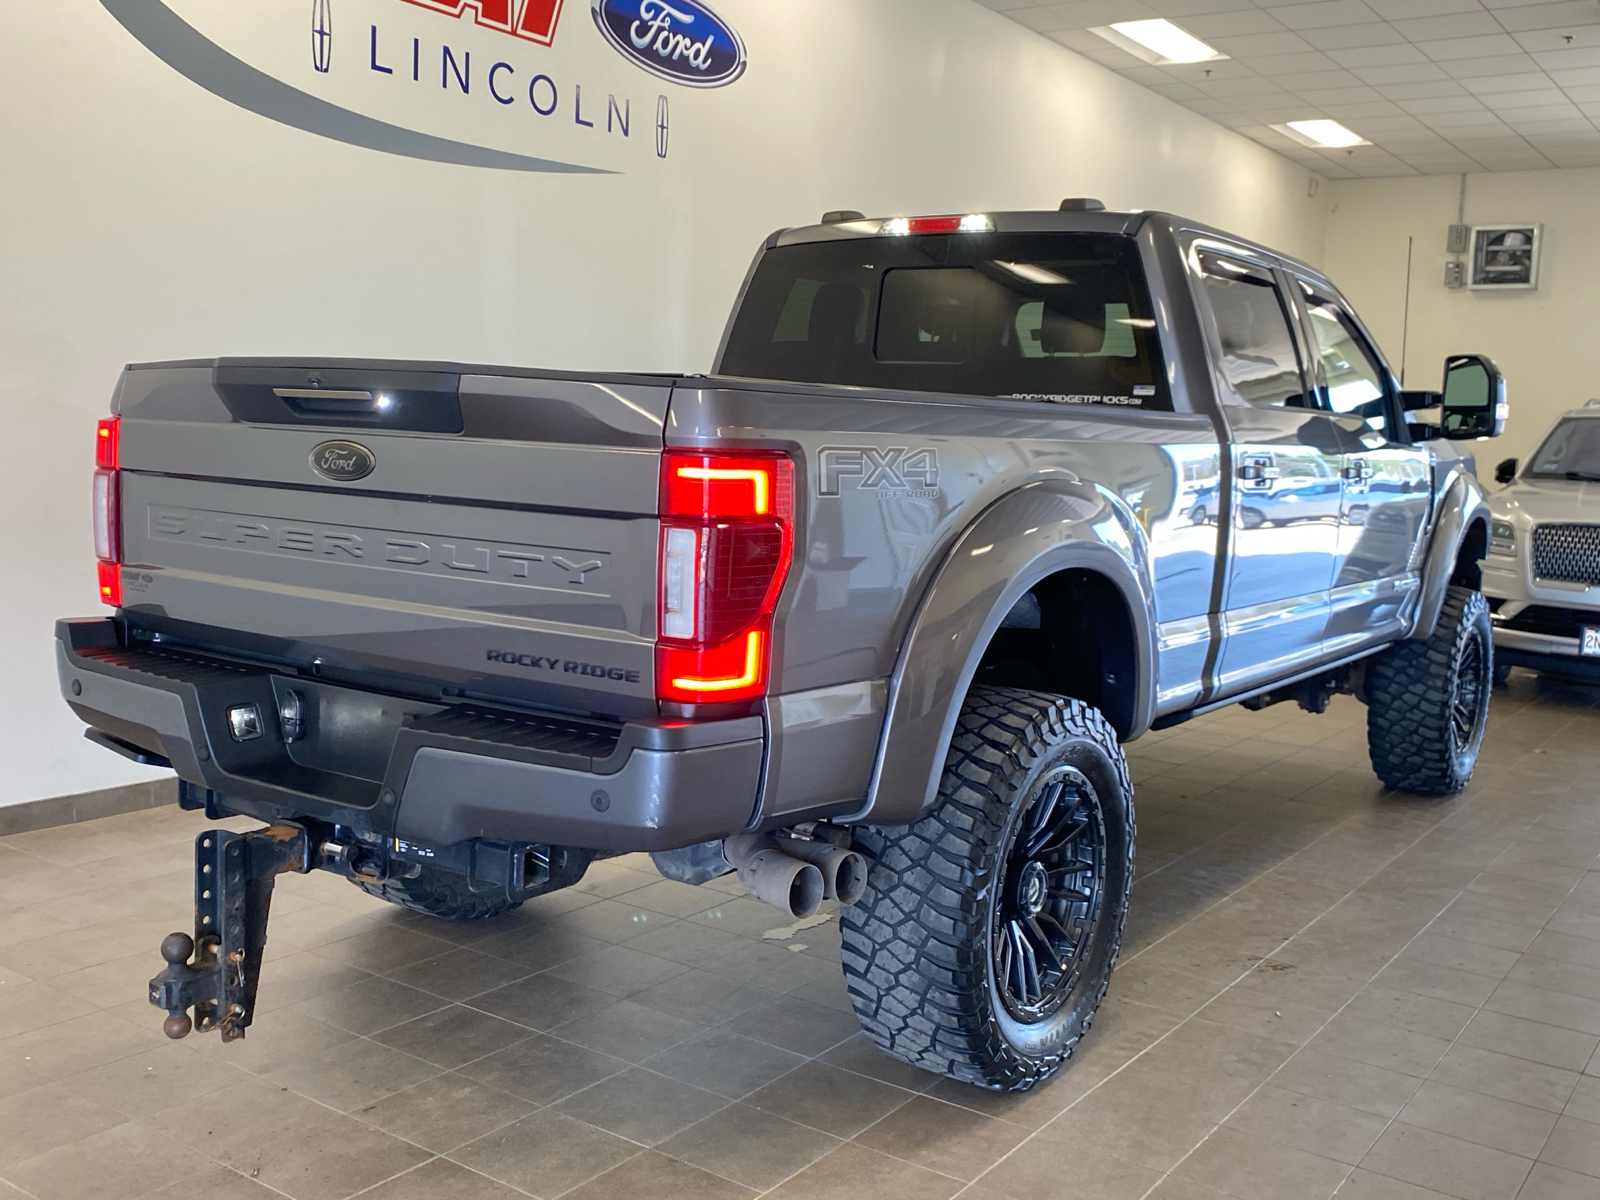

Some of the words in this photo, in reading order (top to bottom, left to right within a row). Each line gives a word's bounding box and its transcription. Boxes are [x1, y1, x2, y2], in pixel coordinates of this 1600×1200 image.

[630, 0, 715, 70] Ford
[370, 25, 630, 138] LINCOLN
[321, 448, 357, 471] Ford
[817, 444, 940, 498] FX4
[875, 489, 901, 499] OFF
[906, 489, 939, 499] ROAD
[154, 510, 364, 559] SUPER
[386, 538, 603, 585] DUTY
[486, 649, 560, 670] ROCKY
[563, 660, 640, 683] RIDGE
